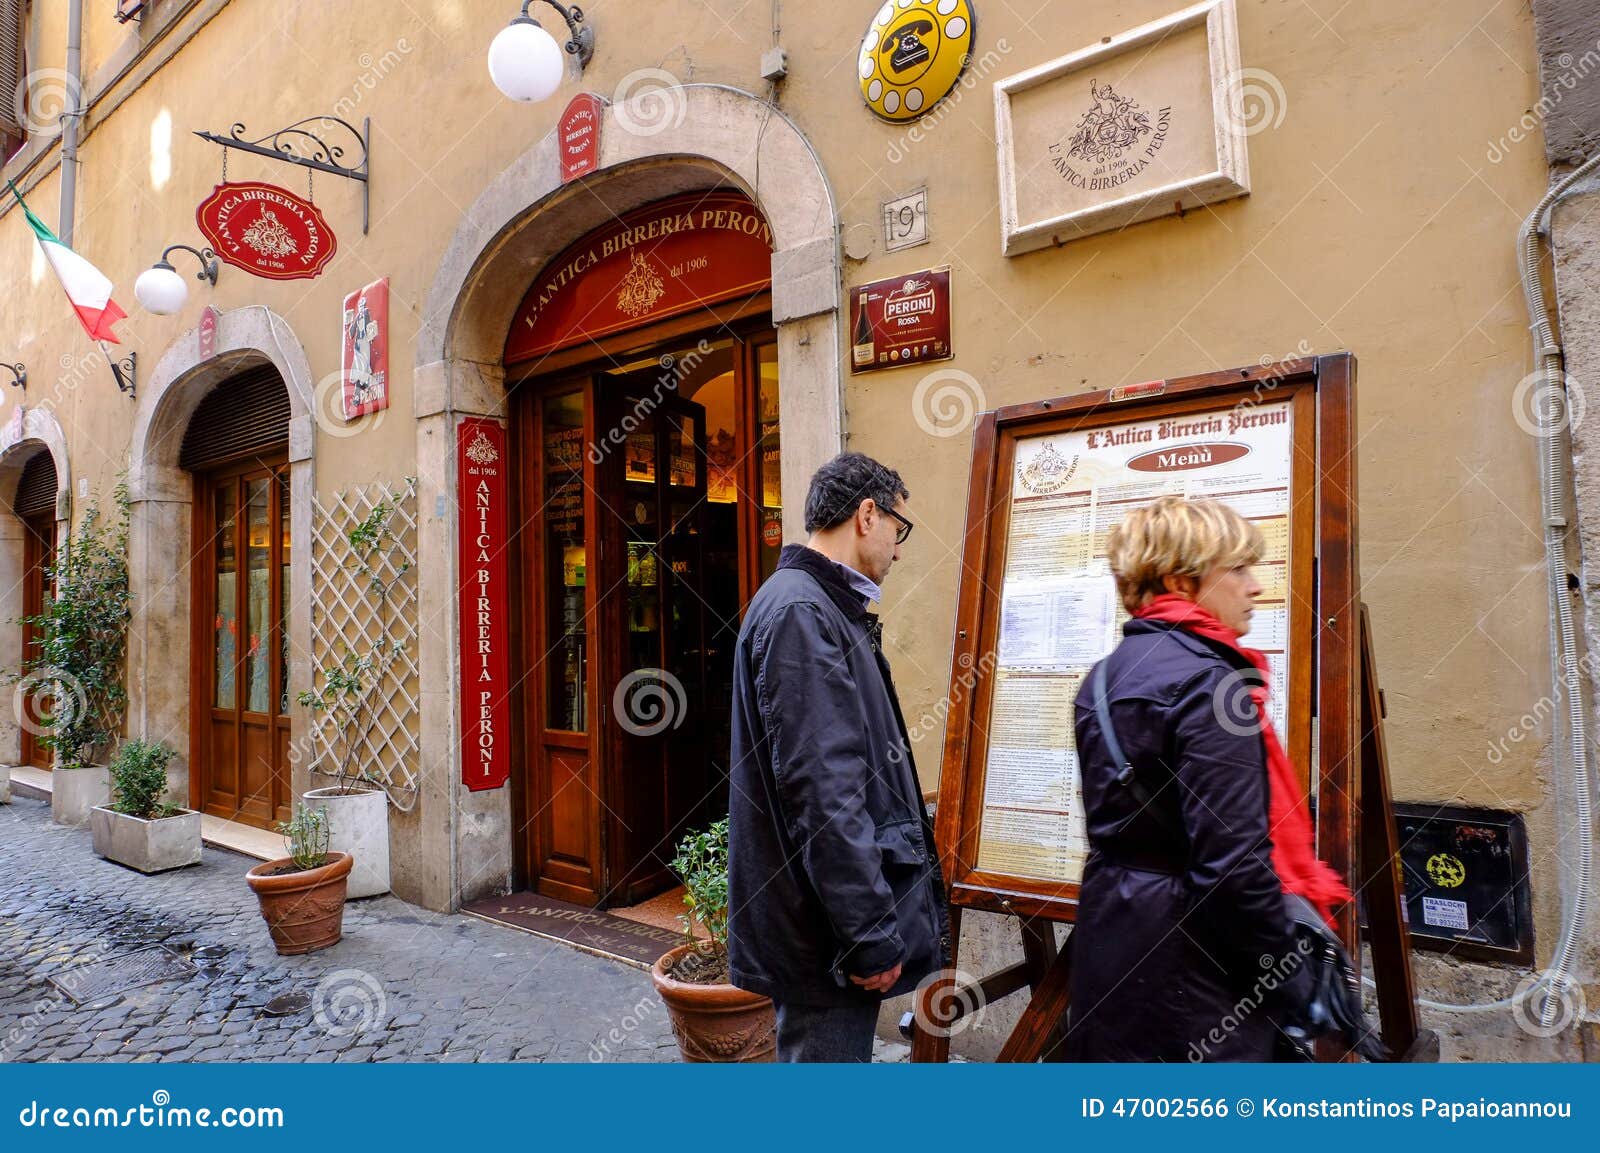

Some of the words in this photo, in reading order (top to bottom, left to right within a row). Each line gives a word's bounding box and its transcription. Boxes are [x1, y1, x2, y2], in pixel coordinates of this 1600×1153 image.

[566, 110, 592, 131] L'ANTICA
[566, 126, 592, 142] BIRRERIA
[569, 138, 590, 154] PERONI
[1089, 158, 1149, 190] BIRRERIA
[1146, 105, 1171, 158] PERONI
[1093, 164, 1106, 175] dal
[1108, 159, 1128, 172] 1906
[217, 195, 242, 253] L'ANTICA
[241, 190, 304, 219] BIRRERIA
[300, 219, 319, 265] PERONI
[256, 258, 267, 266] dal
[269, 260, 285, 269] 1906
[524, 250, 598, 329] L'ANTICA
[602, 214, 695, 258] BIRRERIA
[701, 209, 775, 250] PERON
[670, 264, 684, 278] dal
[685, 255, 708, 273] 1906
[888, 297, 931, 316] PERONI
[897, 316, 920, 327] ROSSA
[1087, 428, 1152, 450] L'Antica
[1158, 416, 1222, 440] Birreria
[1228, 405, 1287, 435] Peroni
[1158, 449, 1212, 468] Menù
[468, 467, 479, 475] dal
[481, 467, 496, 476] 1906
[476, 480, 490, 562] ANTICA
[477, 570, 492, 682] BIRRERIA
[479, 691, 494, 776] PERONI
